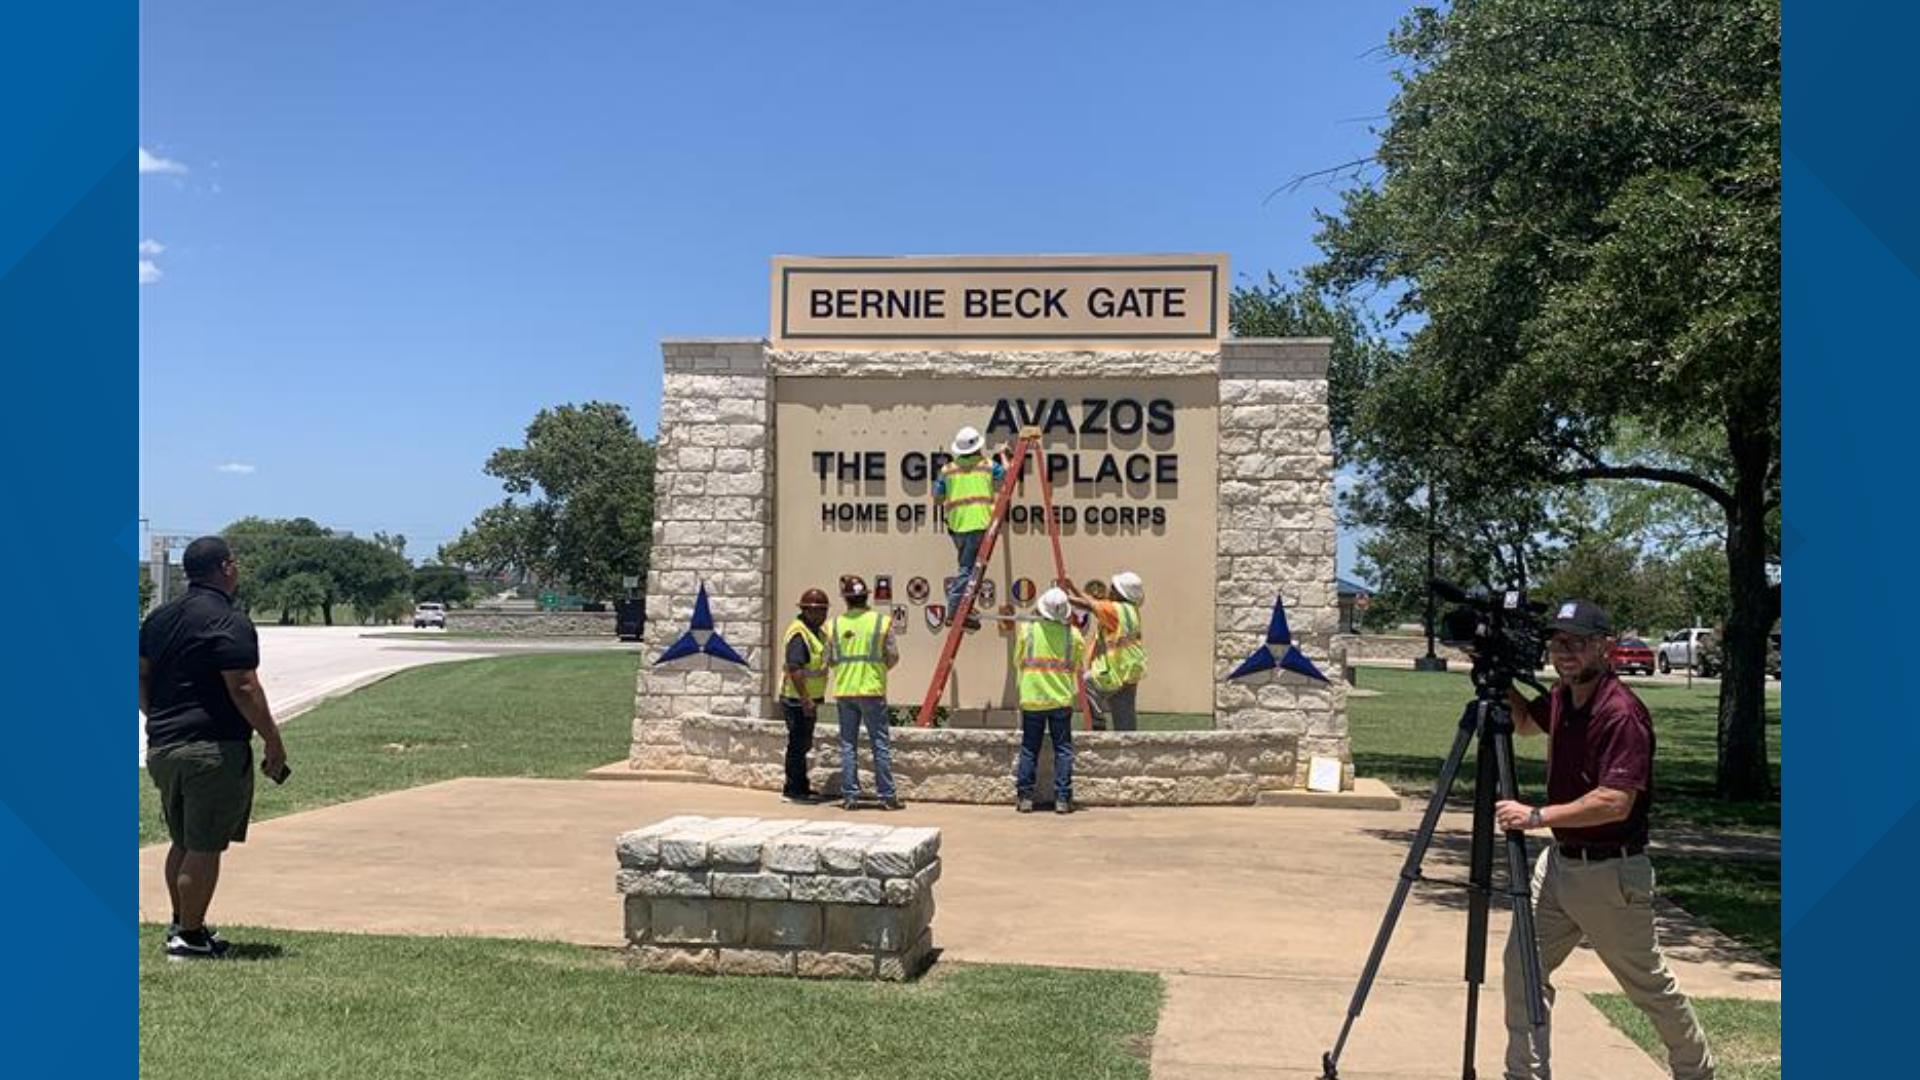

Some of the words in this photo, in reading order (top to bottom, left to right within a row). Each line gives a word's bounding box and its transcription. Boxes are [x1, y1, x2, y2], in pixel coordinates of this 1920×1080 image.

[810, 288, 946, 319] BERNIE
[964, 288, 1069, 318] BECK
[1087, 287, 1187, 318] GATE
[986, 398, 1175, 435] AVAZOS
[812, 451, 886, 481] THE
[1047, 453, 1178, 484] PLACE
[822, 502, 888, 522] HOME
[895, 503, 926, 522] OF
[1084, 506, 1166, 526] CORPS
